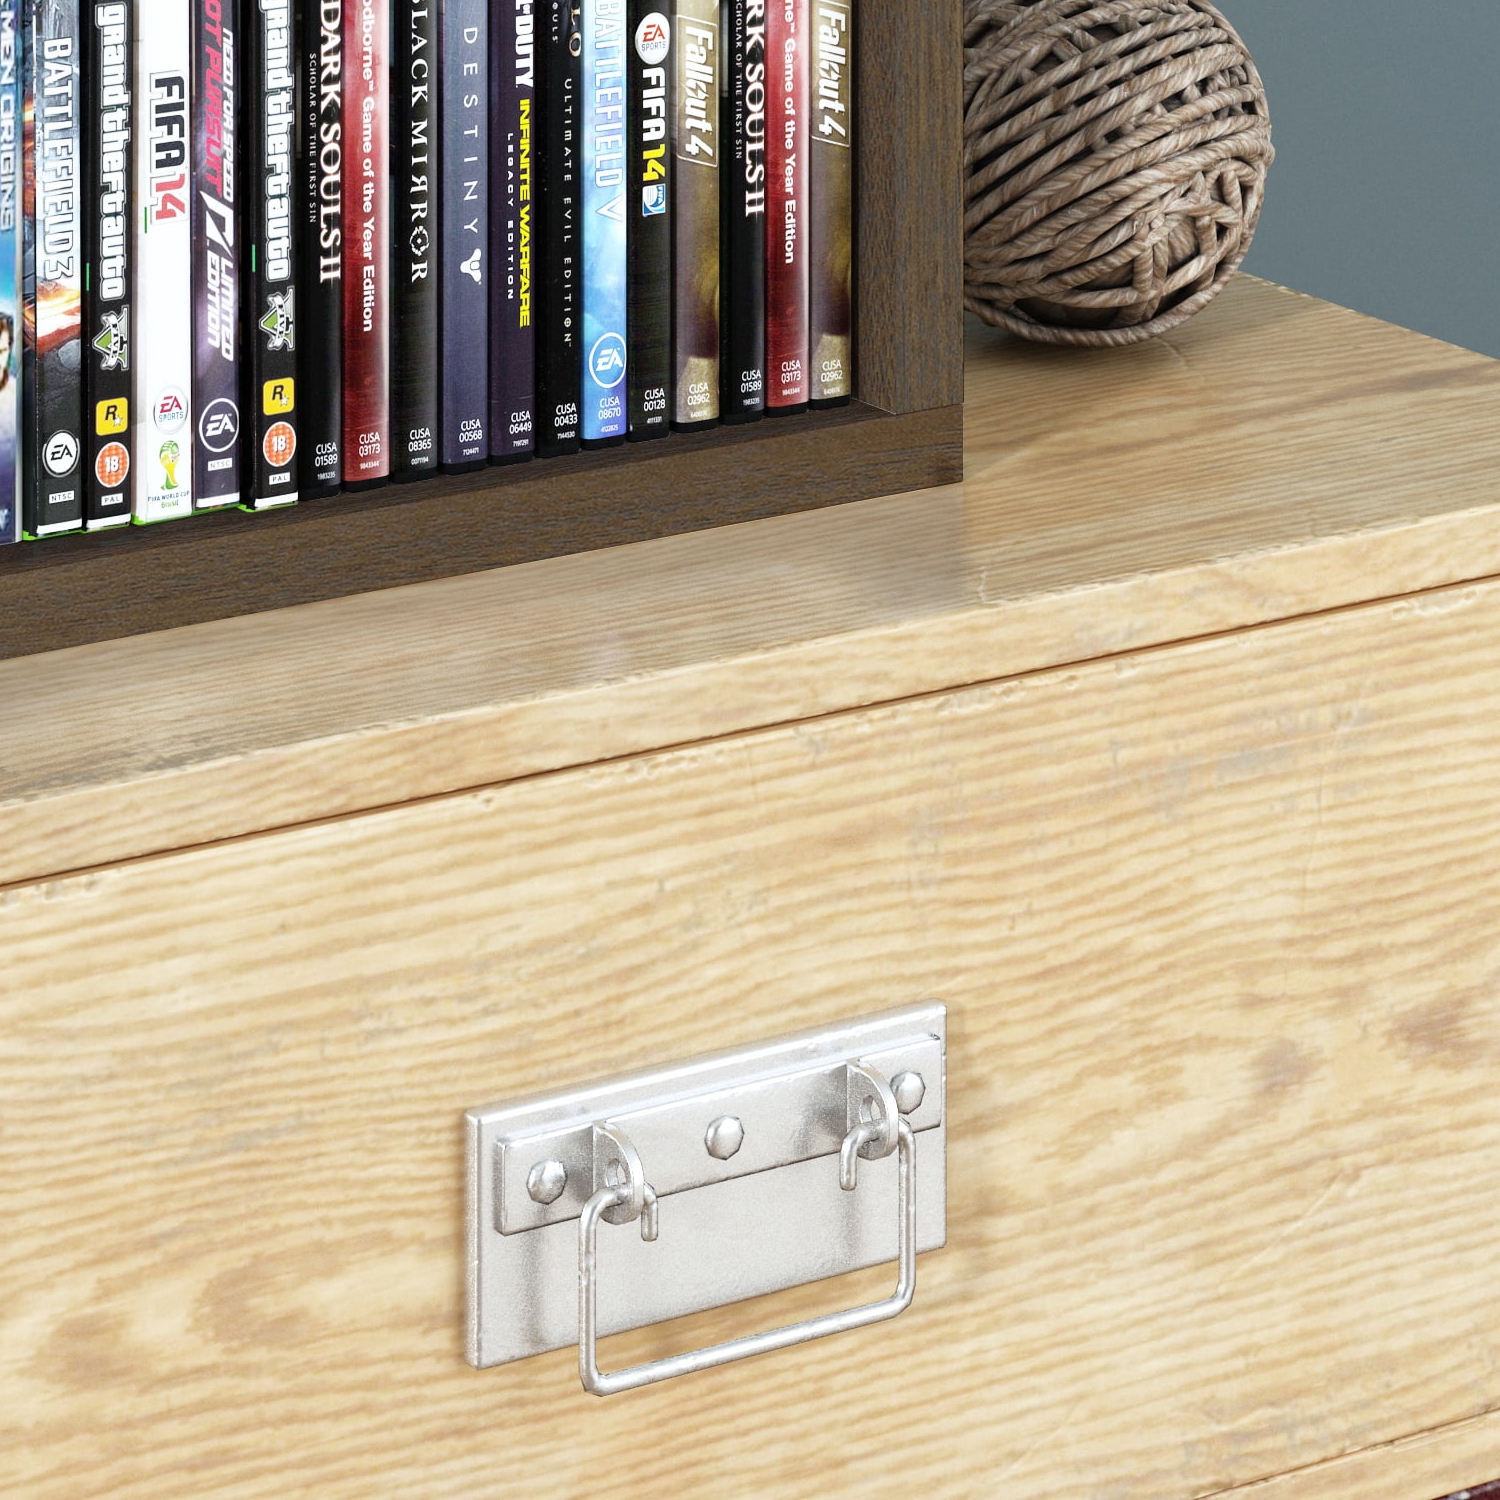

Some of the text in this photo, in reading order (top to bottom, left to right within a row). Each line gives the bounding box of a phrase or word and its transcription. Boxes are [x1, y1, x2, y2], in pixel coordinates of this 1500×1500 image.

[641, 24, 666, 43] EA
[515, 13, 535, 88] DUTY
[640, 42, 667, 54] SPORTS
[735, 53, 743, 70] OF
[784, 37, 798, 93] Game
[818, 6, 846, 138] Fallout 4
[684, 25, 714, 158] Fallout 4
[735, 74, 743, 97] THE
[222, 28, 234, 203] NEED FOR SPEED
[784, 97, 798, 116] of
[204, 45, 222, 198] PURSUIT
[362, 97, 376, 152] Game
[642, 67, 666, 183] FIFA 14
[735, 100, 743, 134] FIRST
[744, 62, 765, 185] SOULS
[309, 52, 318, 223] SCHOLAR OF THE FIRST SIN
[463, 26, 479, 234] DESTINY
[784, 120, 798, 151] the
[155, 75, 186, 221] FIFA 14
[735, 138, 743, 160] SIN
[0, 92, 16, 232] ORIGINS
[362, 158, 376, 178] of
[784, 152, 798, 196] Year
[319, 122, 342, 249] SOULS
[362, 181, 376, 214] the
[595, 192, 624, 222] V
[744, 189, 765, 218] II
[507, 132, 515, 300] LEGACY EDITION
[519, 98, 531, 329] INFINITE WARFARE
[563, 78, 573, 345] ULTIMATE EVIL EDITION
[362, 217, 376, 261] Year
[784, 199, 798, 264] Edition
[319, 251, 342, 284] II
[206, 249, 221, 349] EDITION
[220, 254, 234, 361] LIMITED
[362, 264, 376, 332] Edition
[594, 346, 624, 373] EA
[781, 359, 801, 372] CUSA
[821, 360, 842, 371] CUSA
[741, 370, 761, 382] CUSA
[781, 371, 802, 384] 03173
[821, 370, 843, 383] 02962
[271, 385, 286, 401] R
[644, 388, 665, 400] CUSA
[688, 382, 709, 394] CUSA
[740, 381, 762, 393] 01589
[159, 395, 182, 413] EA
[599, 396, 620, 408] CUSA
[644, 399, 666, 412] 00128
[687, 393, 710, 405] 02962
[104, 405, 119, 421] R
[158, 411, 184, 423] SPORTS
[511, 410, 531, 422] CUSA
[555, 403, 577, 415] CUSA
[598, 407, 621, 420] 08670
[205, 413, 235, 437] EA
[461, 419, 481, 431] CUSA
[509, 421, 532, 434] 06449
[554, 413, 578, 427] 00433
[272, 434, 288, 452] 18
[359, 432, 380, 444] CUSA
[409, 427, 430, 440] CUSA
[459, 430, 483, 443] 00568
[49, 443, 73, 462] EA
[316, 443, 337, 454] CUSA
[359, 443, 380, 457] 03173
[408, 438, 432, 452] 08365
[103, 455, 120, 473] 18
[315, 453, 338, 467] 01589
